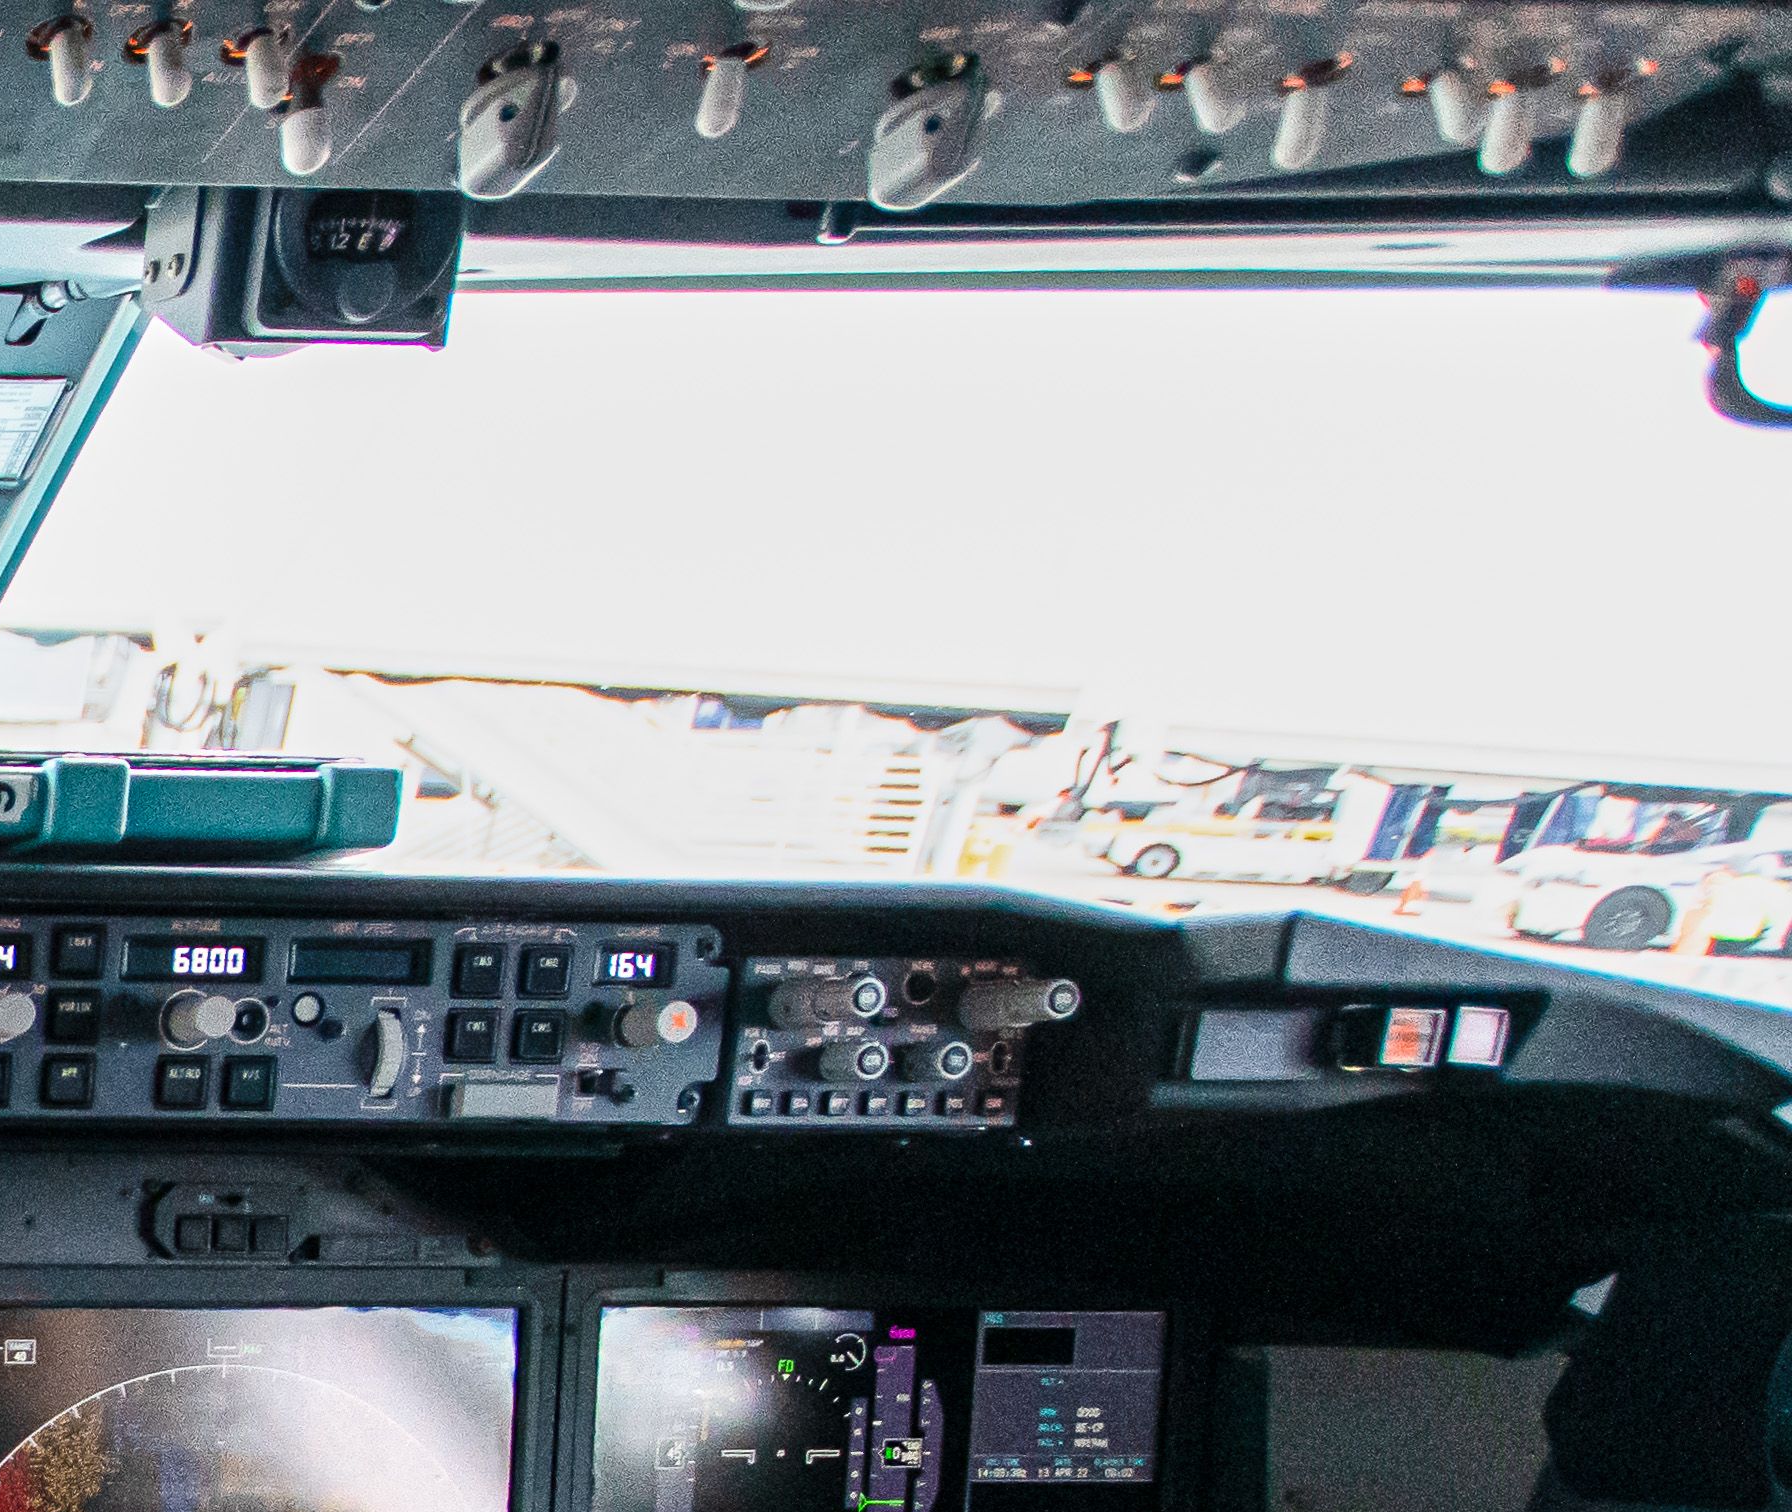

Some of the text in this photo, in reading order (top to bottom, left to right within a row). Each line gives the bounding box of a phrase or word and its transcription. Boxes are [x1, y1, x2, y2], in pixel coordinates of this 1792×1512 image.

[173, 946, 245, 972] 6800
[609, 953, 655, 977] 164
[778, 1361, 794, 1372] FD
